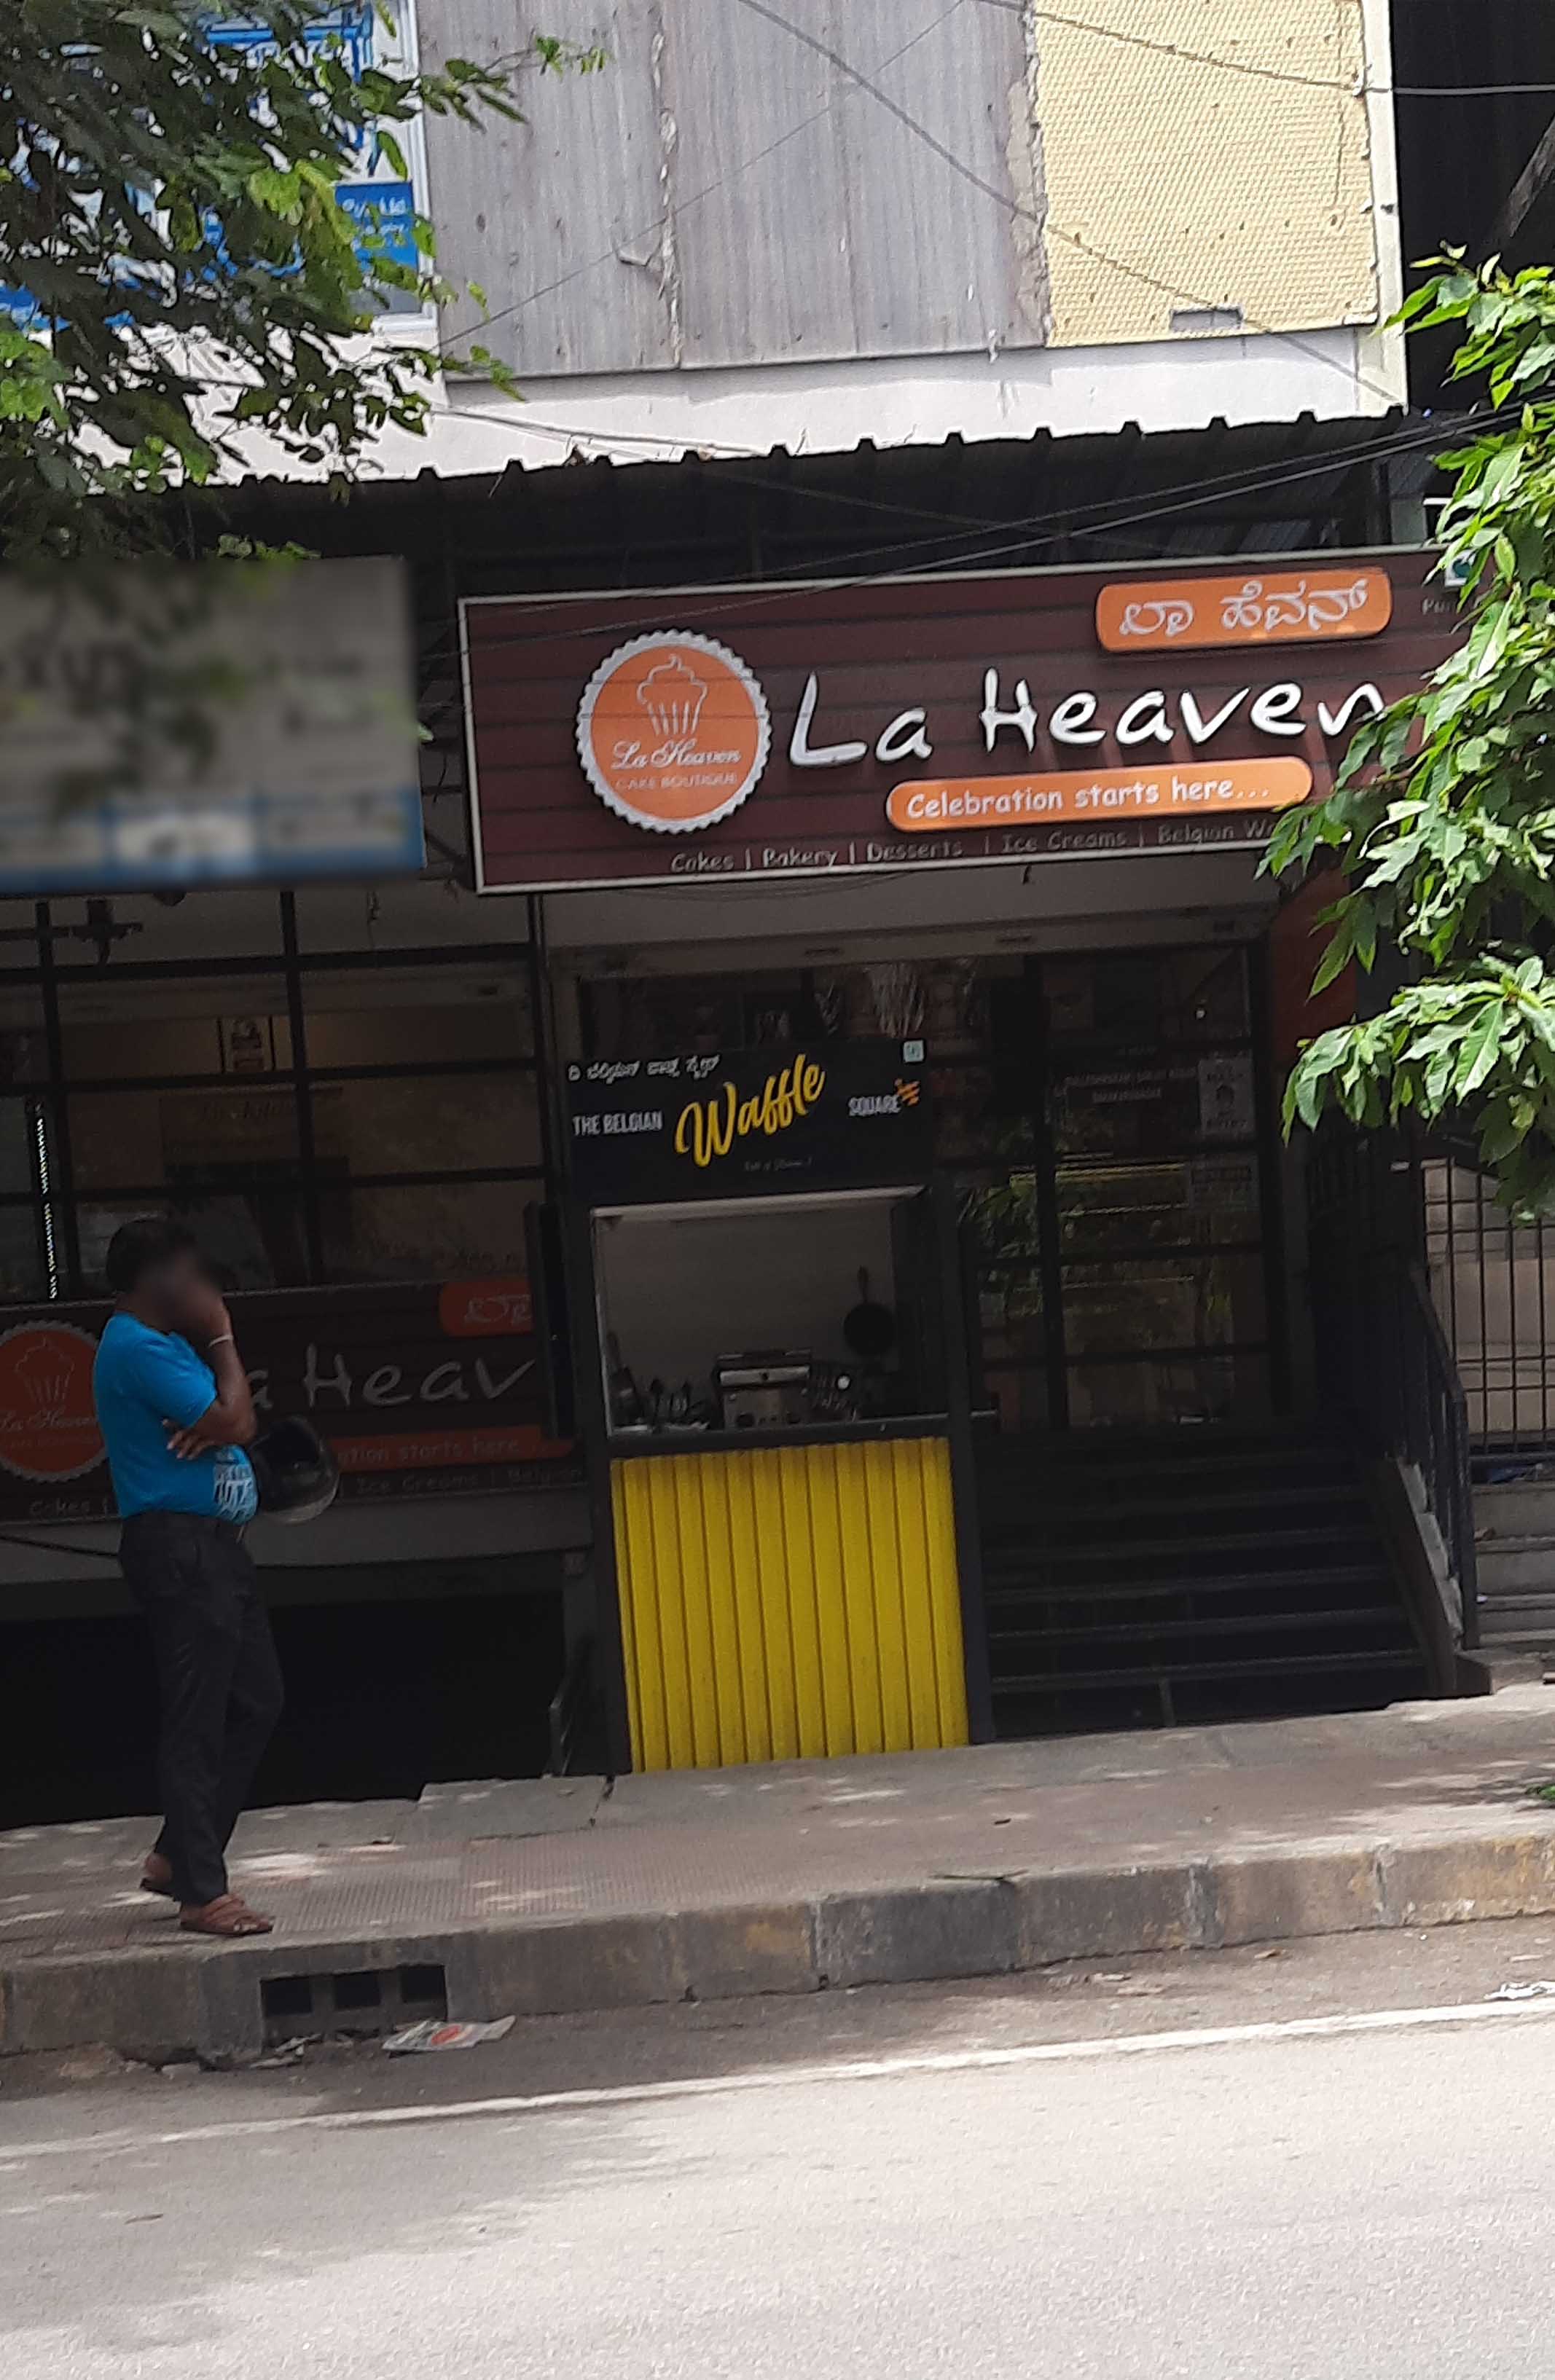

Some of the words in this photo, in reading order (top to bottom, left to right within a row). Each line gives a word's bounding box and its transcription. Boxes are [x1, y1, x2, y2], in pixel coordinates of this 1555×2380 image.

[1119, 600, 1194, 635] ಲಾ
[789, 669, 933, 766] La
[980, 666, 1385, 753] Heaven
[611, 739, 648, 770] La
[651, 737, 741, 768] Heaven
[906, 786, 1062, 820] Celebration
[1076, 783, 1159, 809] starts
[670, 850, 735, 873] Cakes
[763, 847, 838, 867] Bakery
[867, 841, 963, 863] Desserts
[1002, 833, 1038, 853] Ice
[1047, 828, 1127, 851] Creams
[573, 1114, 601, 1136] THE
[603, 1110, 663, 1135] BELGIAN
[674, 1053, 827, 1168] Waffle
[848, 1094, 902, 1117] SQUARE
